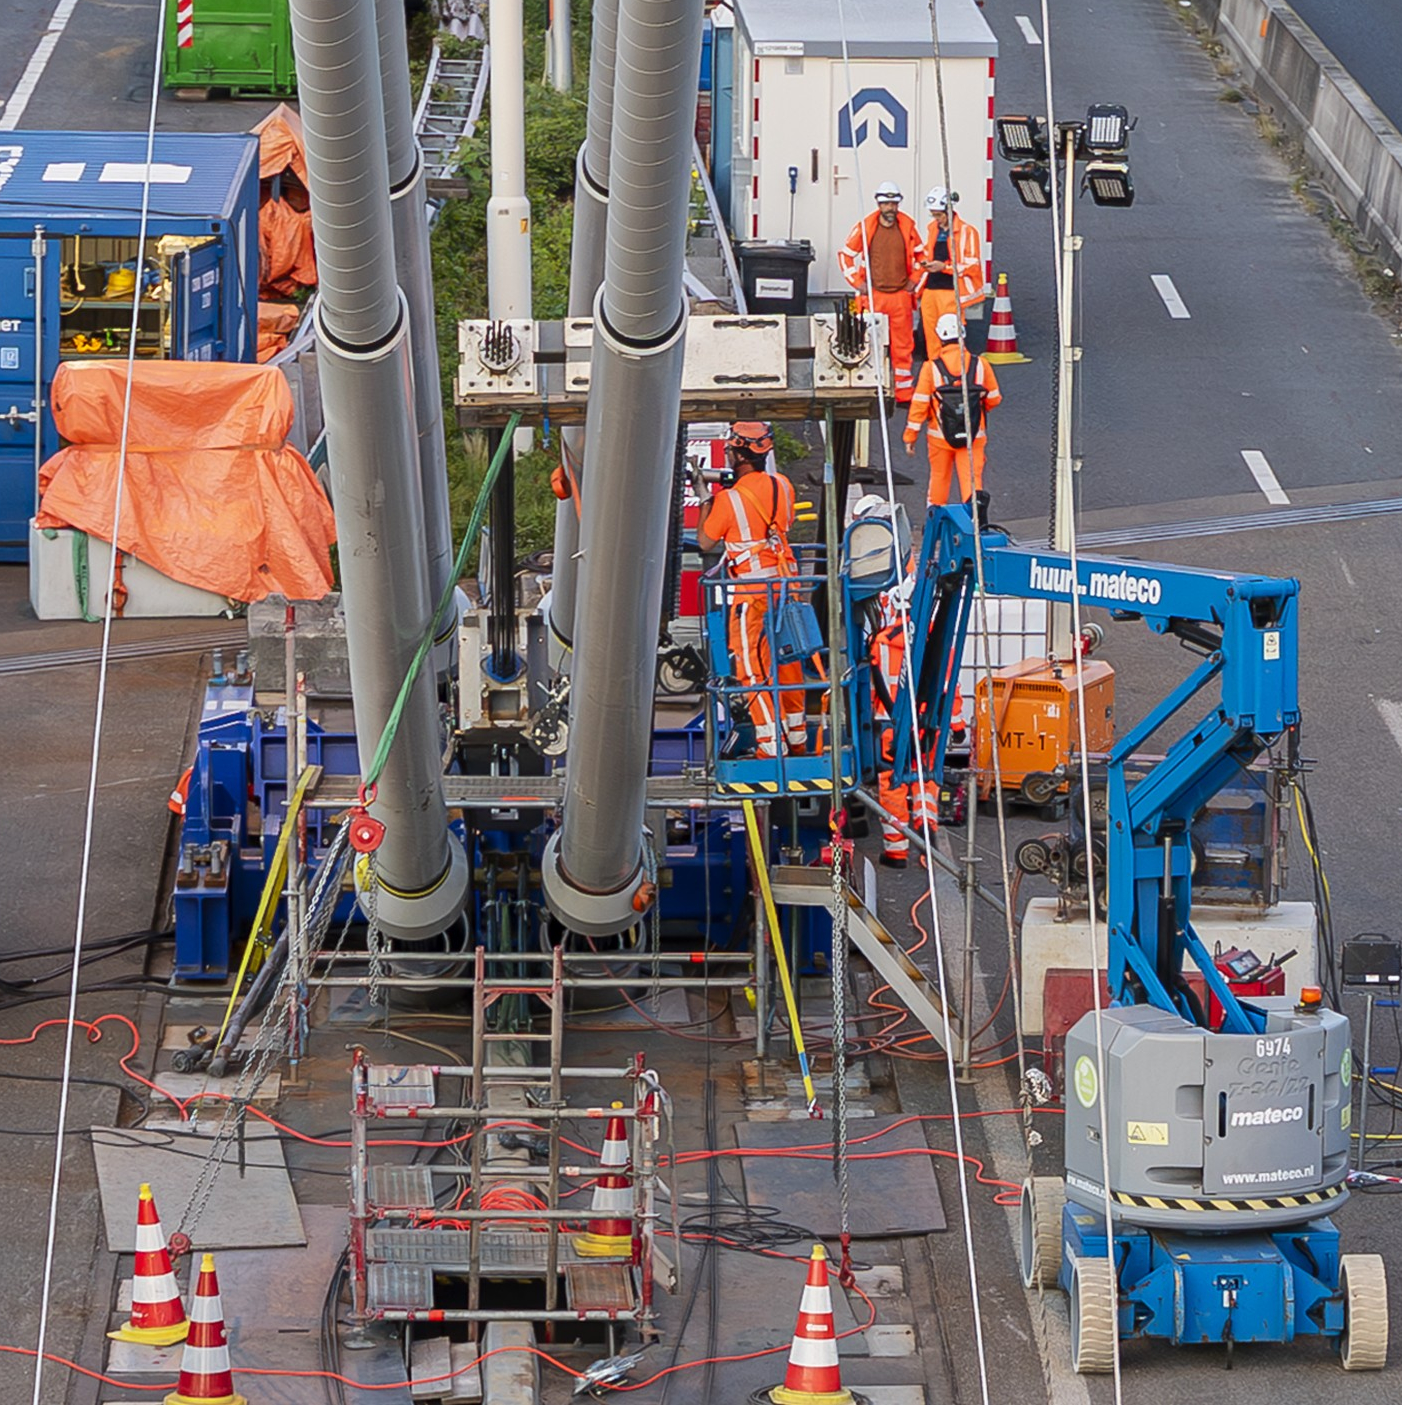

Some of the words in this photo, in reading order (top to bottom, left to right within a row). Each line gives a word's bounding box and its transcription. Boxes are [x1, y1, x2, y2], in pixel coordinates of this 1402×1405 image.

[1089, 569, 1162, 605] mateco
[1255, 1037, 1292, 1058] 6974
[1237, 1055, 1300, 1076] Genie
[1230, 1106, 1304, 1128] mateco
[1222, 1164, 1315, 1185] www.mateco.nl
